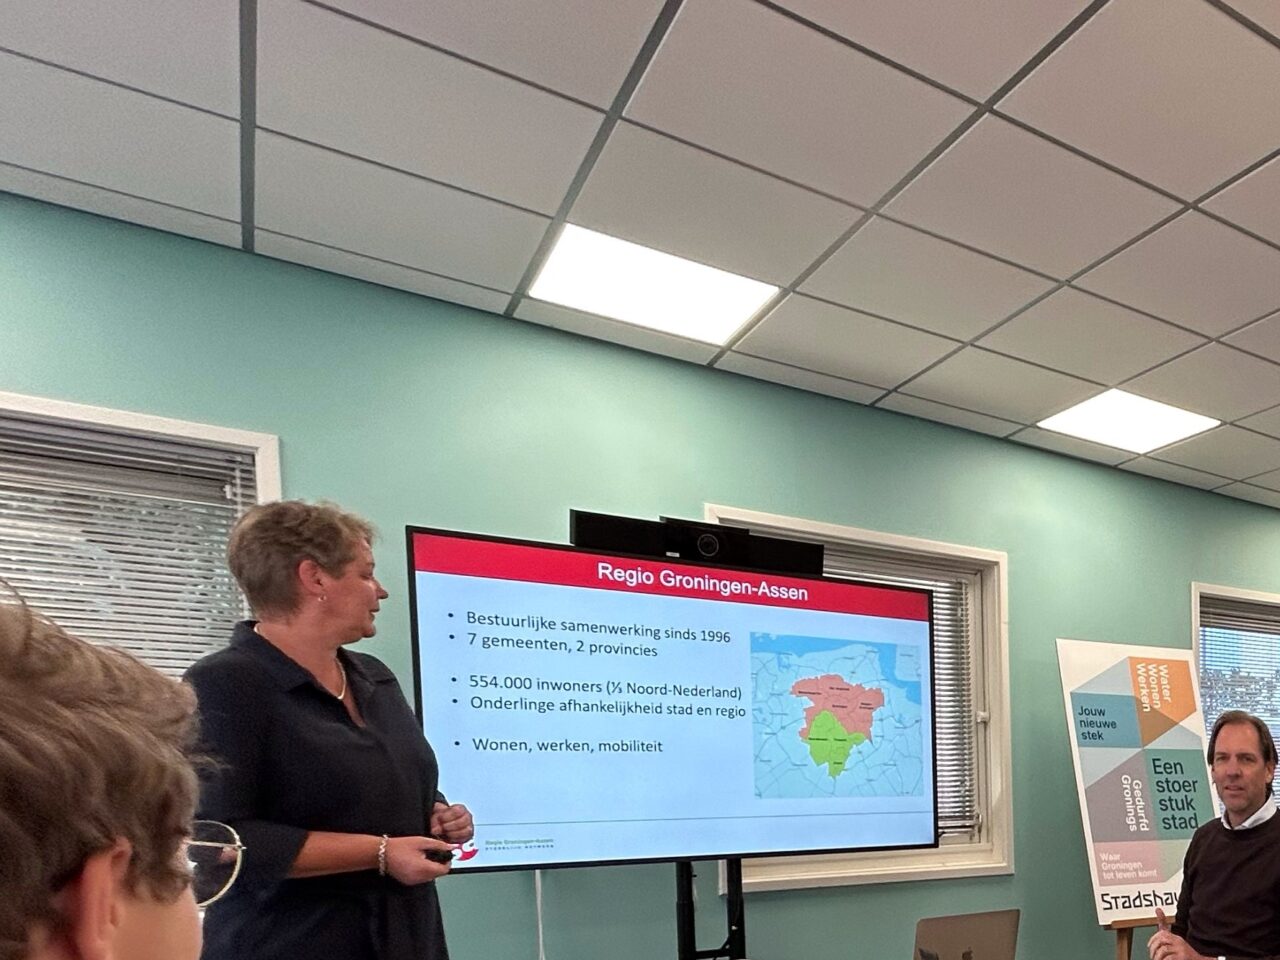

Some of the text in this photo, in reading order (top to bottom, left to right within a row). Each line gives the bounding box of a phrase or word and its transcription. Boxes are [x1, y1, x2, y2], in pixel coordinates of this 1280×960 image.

[597, 562, 808, 601] Regio Groningen-Assen
[467, 611, 731, 643] Bestuurlijke samenwerking sinds 1996
[467, 632, 658, 657] 7 gemeenten, 2 provincies
[469, 674, 532, 690] 554.000
[536, 677, 602, 693] inwoners
[626, 682, 742, 701] Noord-Nederland)
[1136, 662, 1151, 712] Werken
[1147, 663, 1161, 708] Wonen
[1158, 664, 1172, 703] Water
[470, 696, 746, 720] Onderlinge afhankelijkheid stad en regio
[1078, 706, 1106, 717] Jouw
[1079, 718, 1117, 729] nieuwe
[1081, 731, 1104, 740] stek
[472, 738, 663, 754] Wonen, werken, mobiliteit
[1152, 758, 1184, 775] Een
[1156, 777, 1198, 793] stoer
[1121, 774, 1138, 832] Gronings
[1132, 779, 1150, 832] Gedurfd
[1159, 794, 1196, 812] stuk
[1162, 812, 1199, 830] stad
[1100, 853, 1121, 861] Waar
[1101, 861, 1143, 871] Groningen
[1103, 872, 1115, 880] tot
